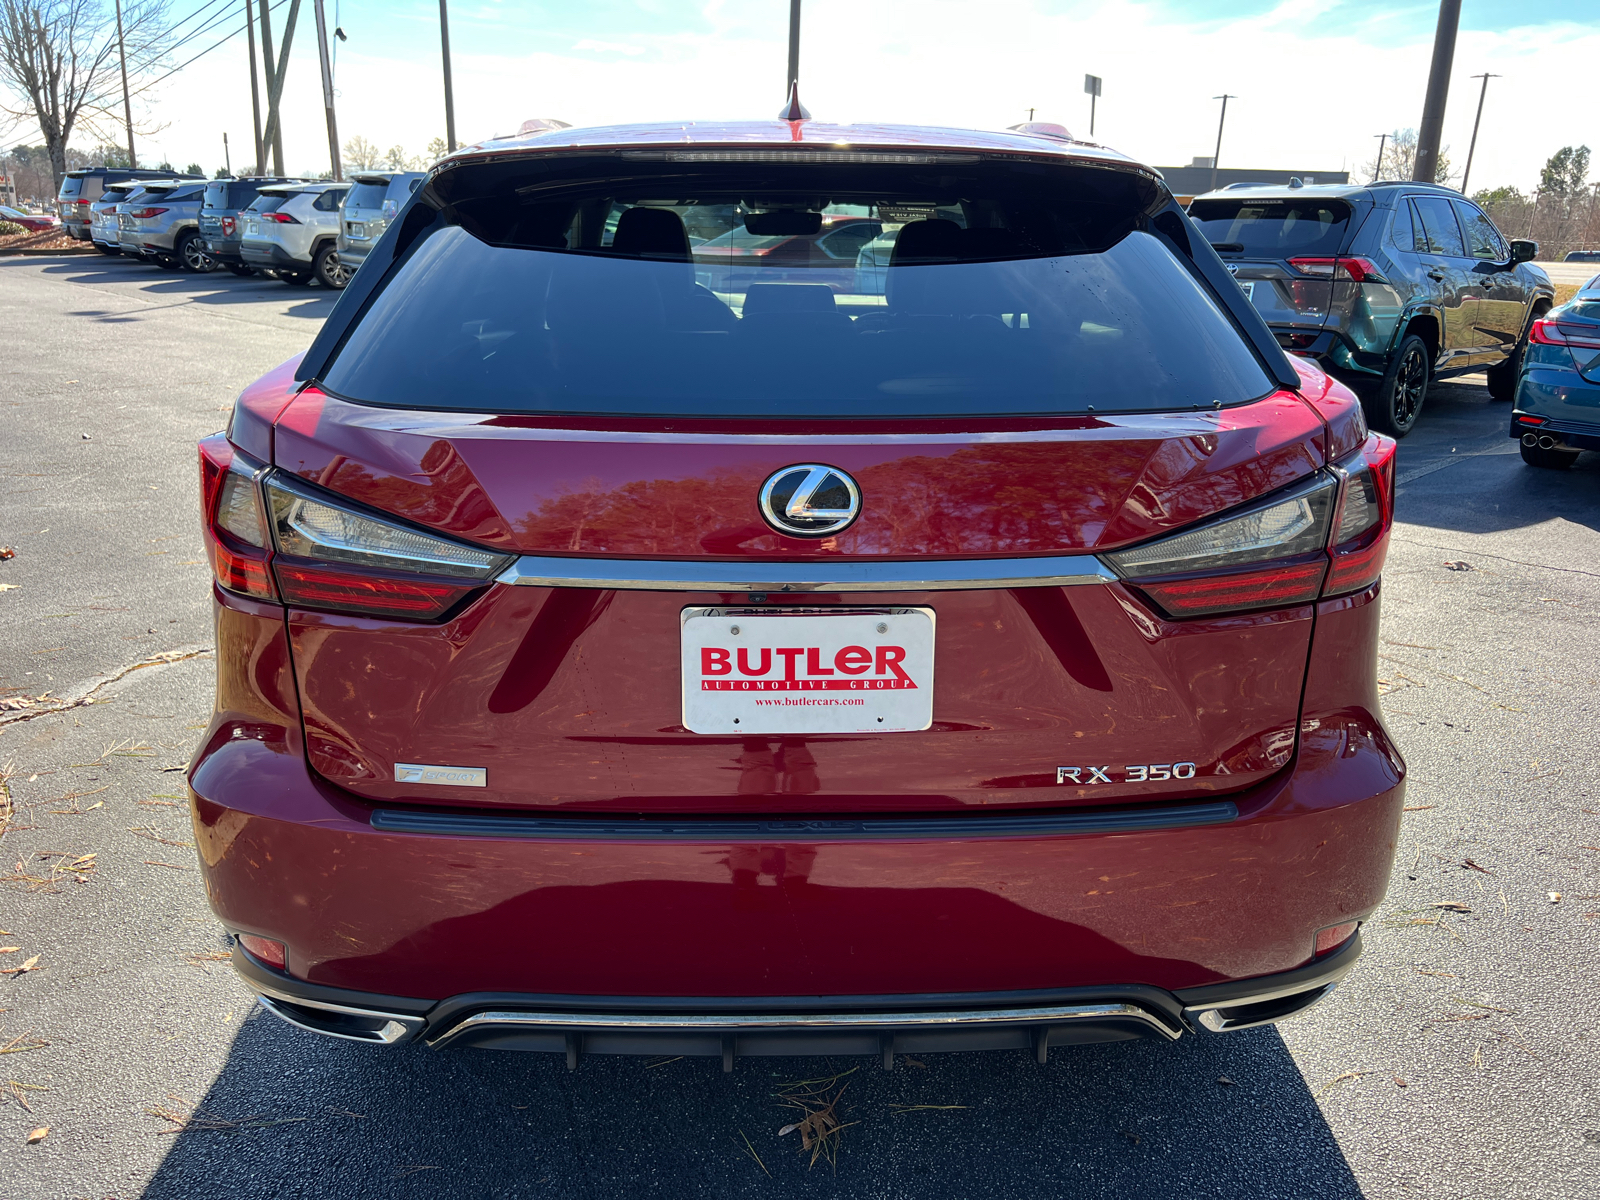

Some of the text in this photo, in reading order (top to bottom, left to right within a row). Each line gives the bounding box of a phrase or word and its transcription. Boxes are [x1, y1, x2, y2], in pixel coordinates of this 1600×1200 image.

[703, 679, 911, 690] AUTOMOTIVE GROUP
[755, 697, 865, 706] www.butlercars.com
[425, 771, 479, 782] SPORT
[1056, 762, 1196, 784] RX 350
[767, 821, 856, 830] LEXUS
